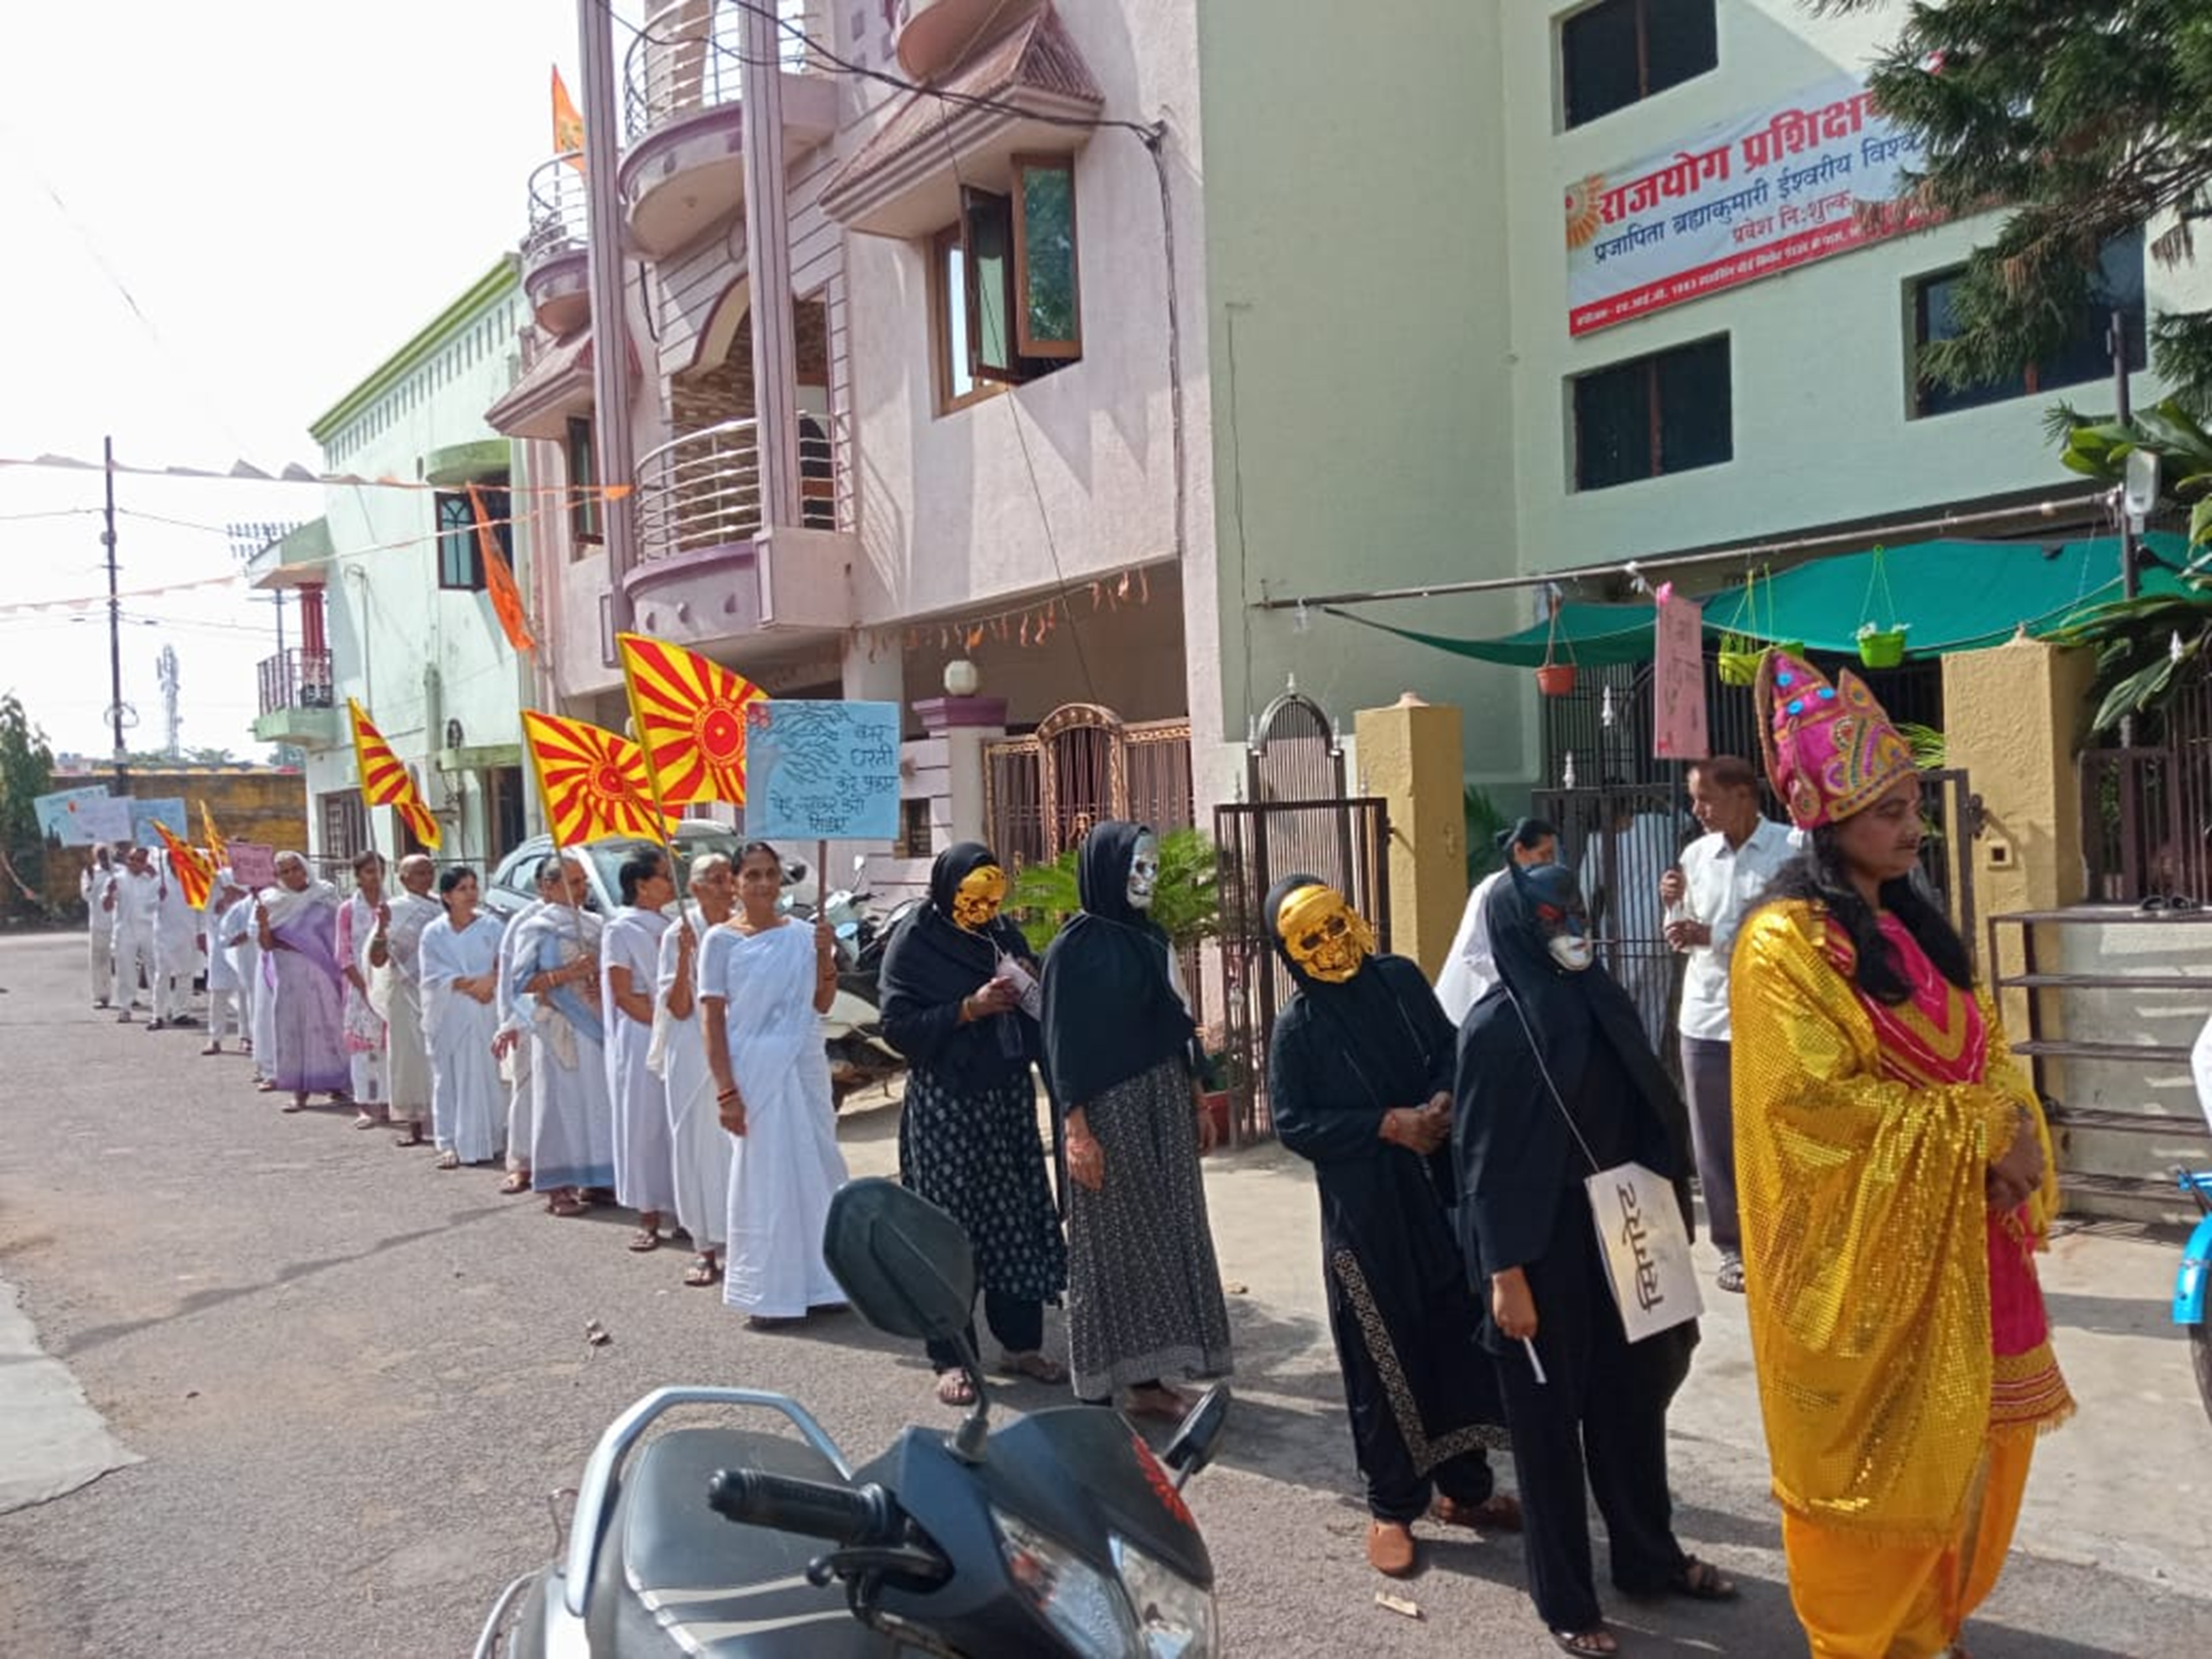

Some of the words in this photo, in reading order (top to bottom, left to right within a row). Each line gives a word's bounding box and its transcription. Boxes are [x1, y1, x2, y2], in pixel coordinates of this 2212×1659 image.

[1594, 223, 1665, 263] प्रजापिता
[1777, 153, 1852, 198] ईश्वरीय
[1861, 137, 1922, 168] विश्व
[1600, 145, 1731, 224] राजयोग
[1616, 1182, 1664, 1314] सिगरेट
